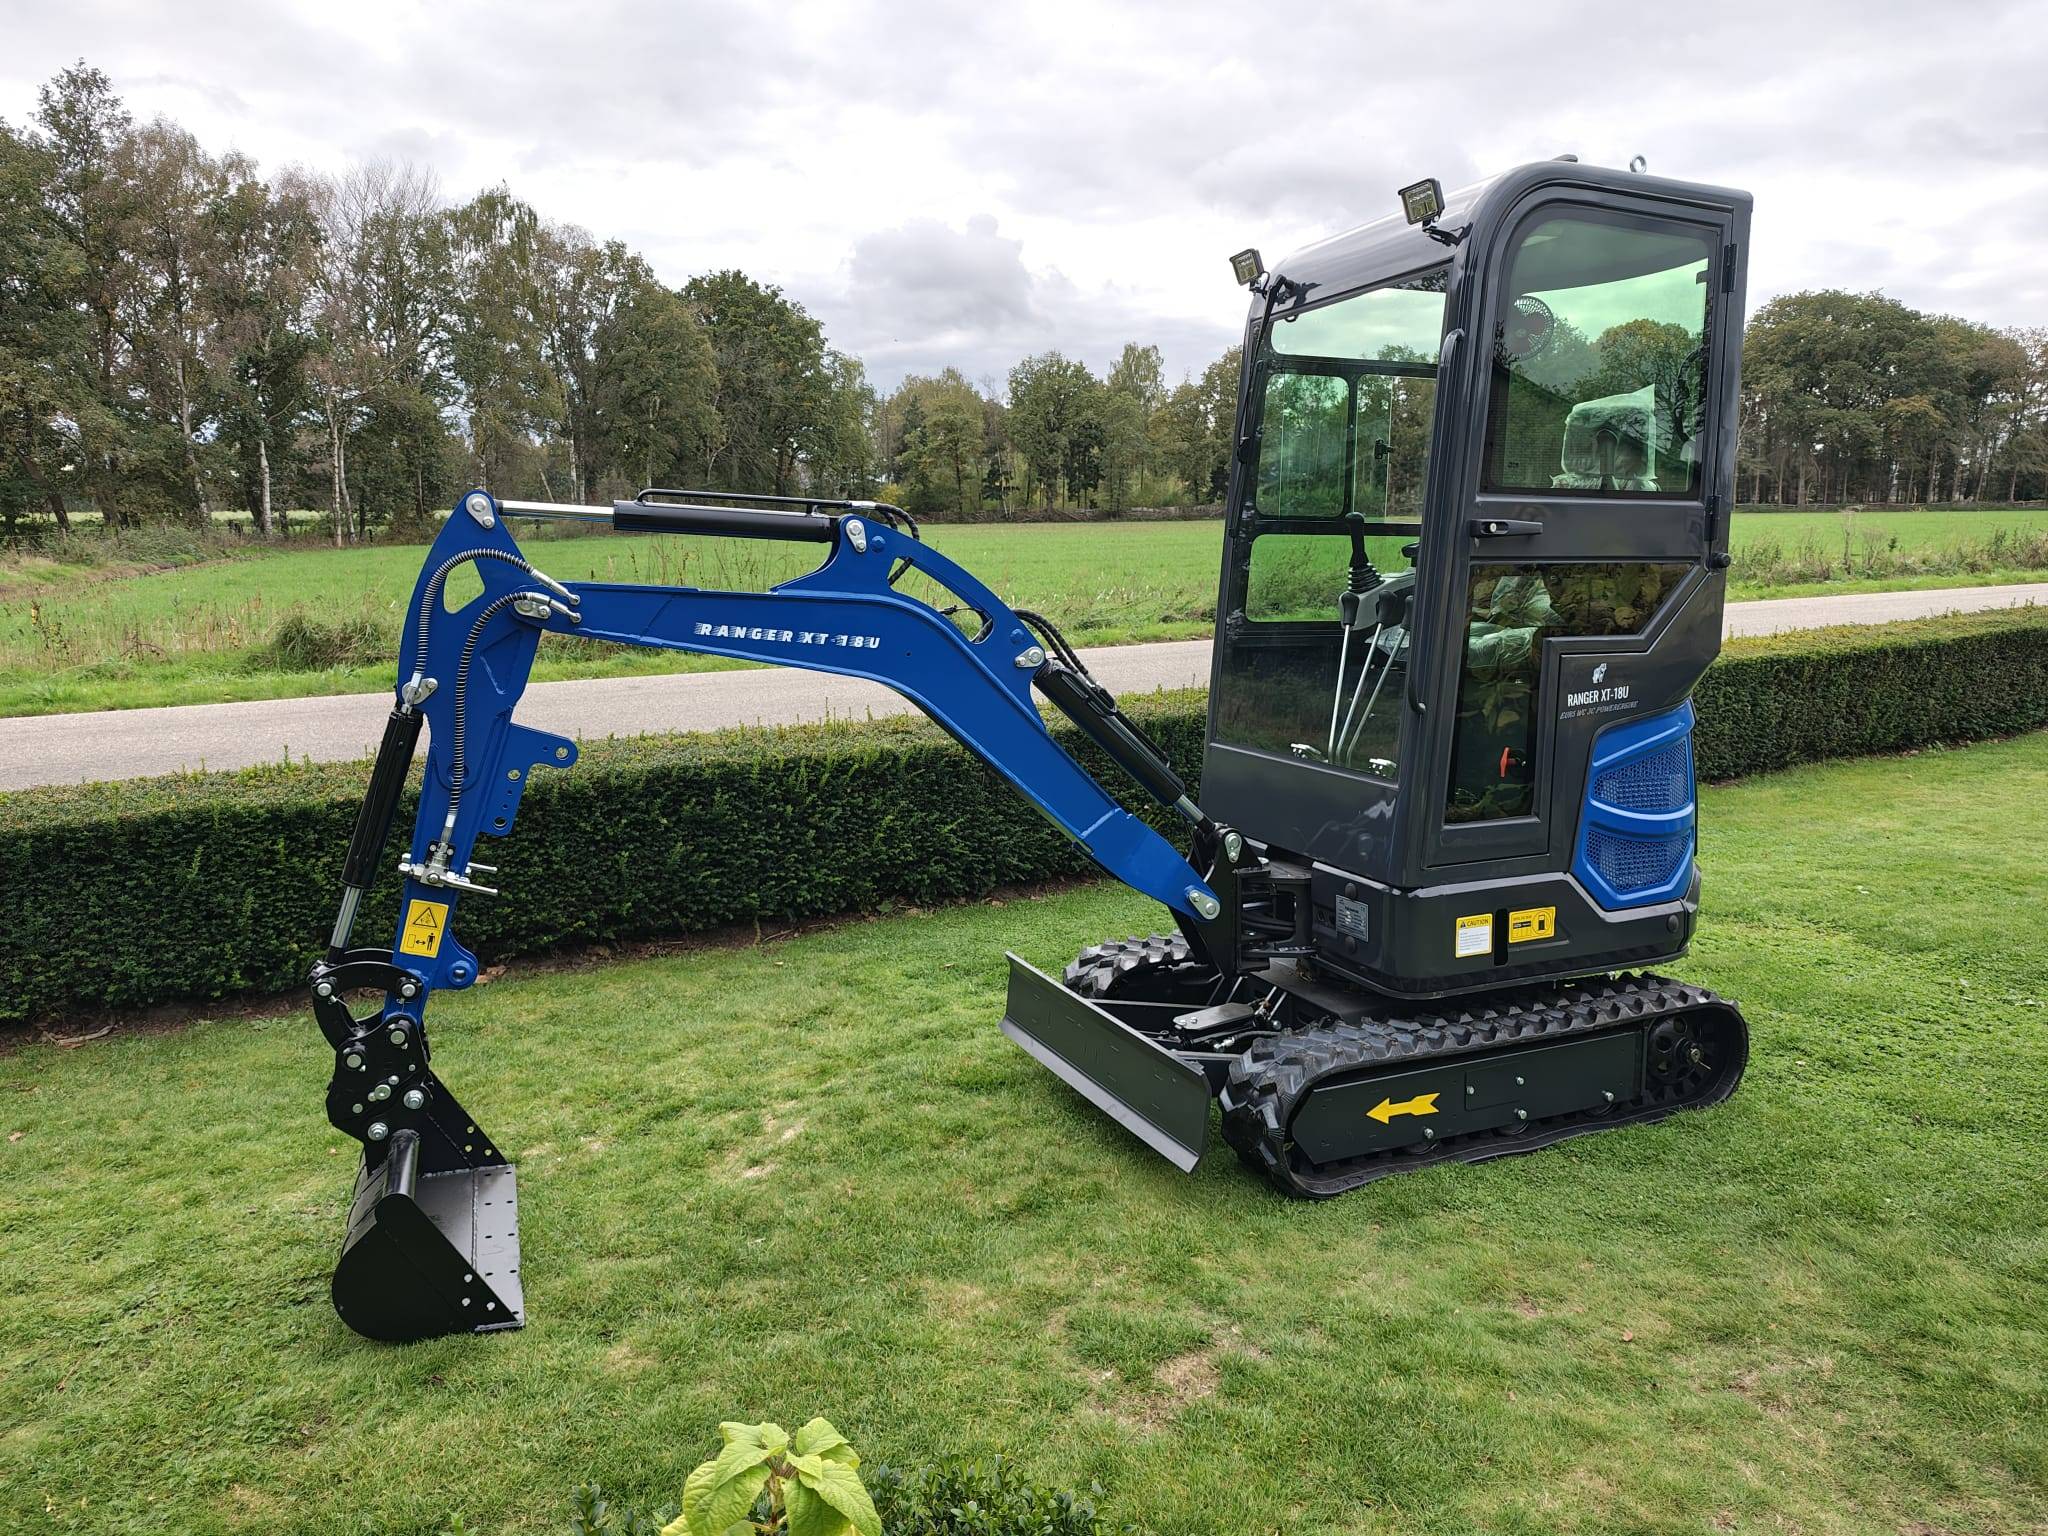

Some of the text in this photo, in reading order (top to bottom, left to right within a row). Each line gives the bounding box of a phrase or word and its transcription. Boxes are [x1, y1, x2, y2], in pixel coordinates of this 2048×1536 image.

[696, 622, 880, 649] RANGER XT-18U
[1567, 686, 1630, 707] RANGER XT-18U
[1466, 918, 1489, 927] CAUTION
